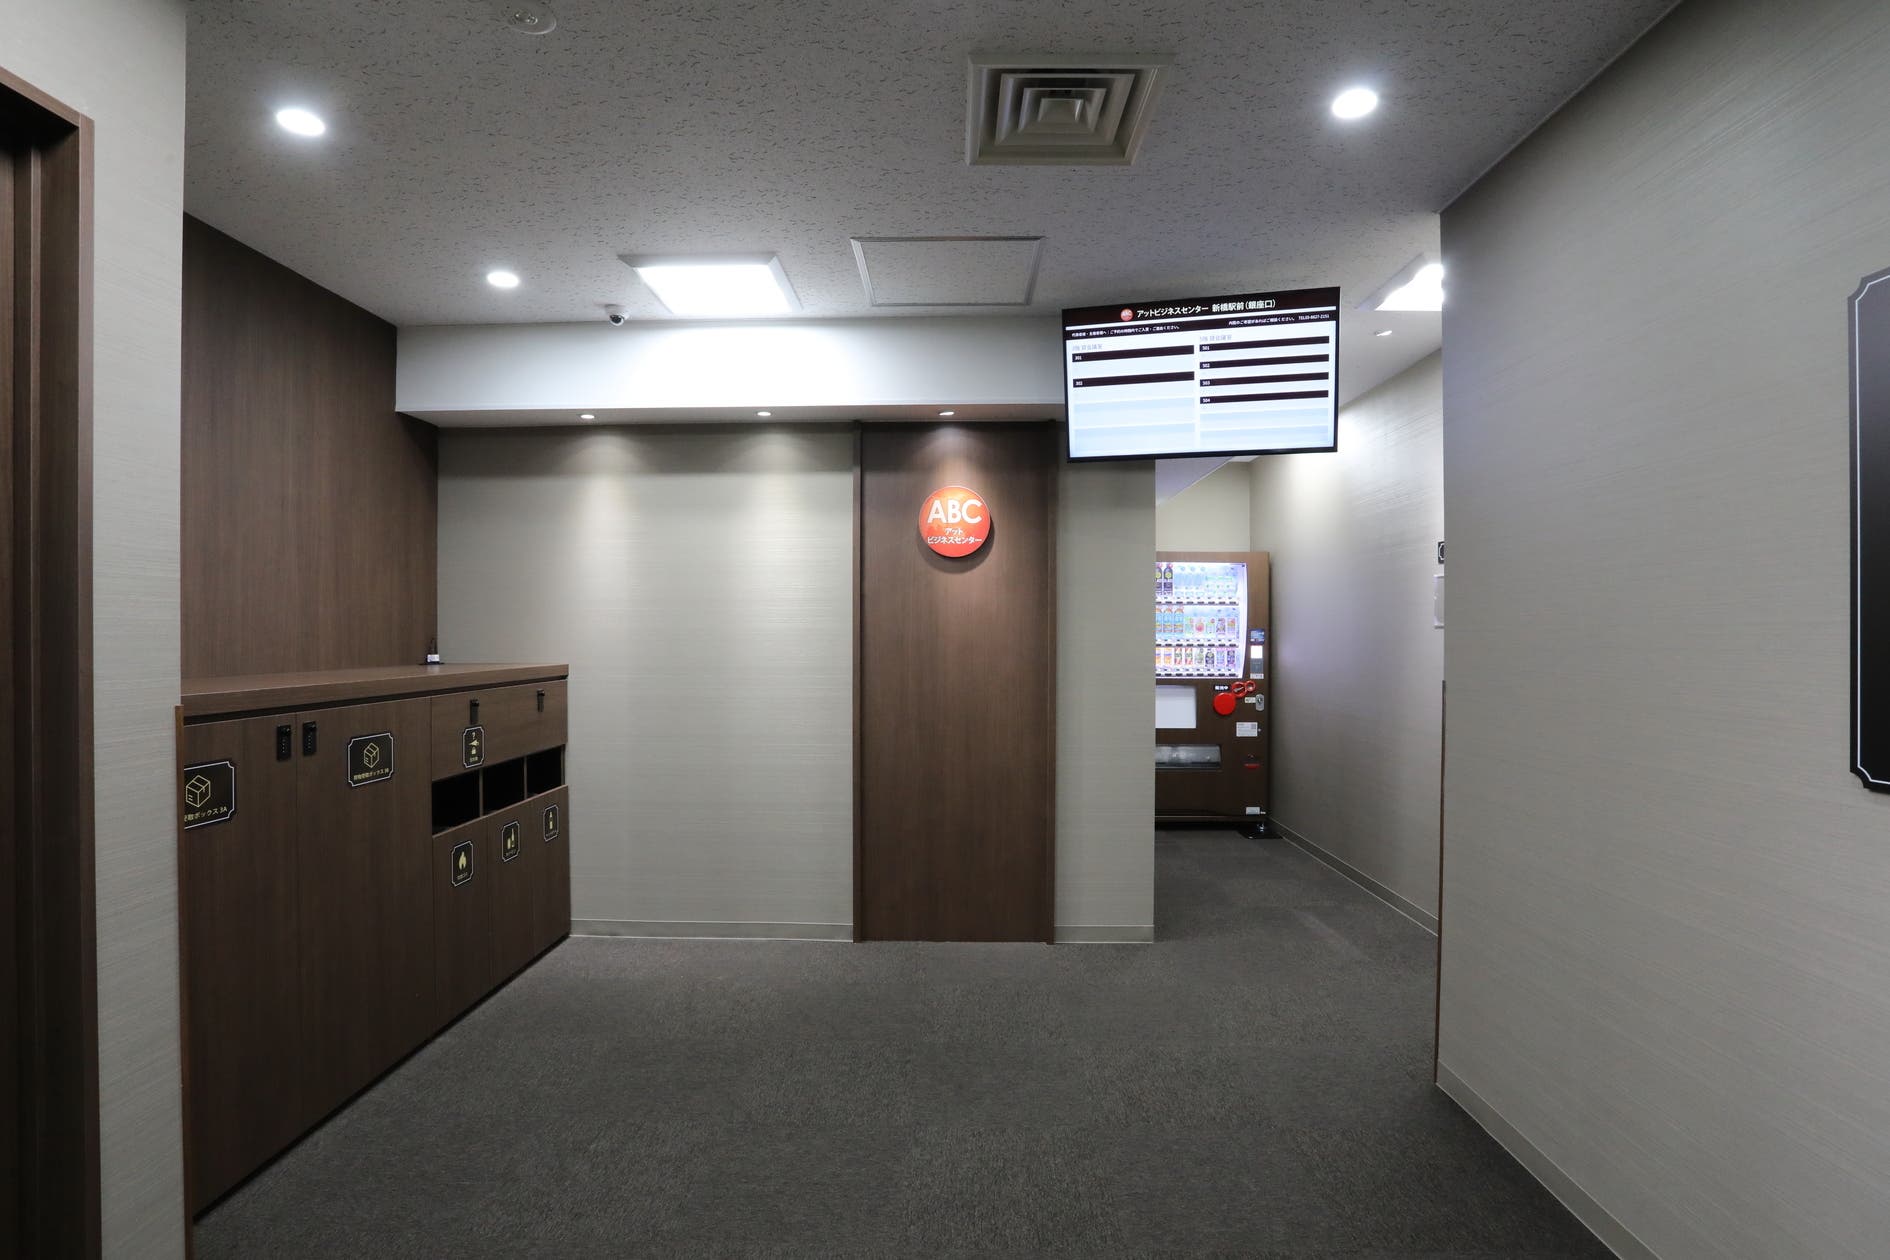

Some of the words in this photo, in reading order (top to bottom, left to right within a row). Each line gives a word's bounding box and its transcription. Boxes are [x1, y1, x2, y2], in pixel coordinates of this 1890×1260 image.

[1137, 305, 1209, 318] アットビジネスセンター
[927, 499, 982, 524] ABC
[945, 527, 963, 535] アット
[927, 536, 982, 544] ビジネスセンター
